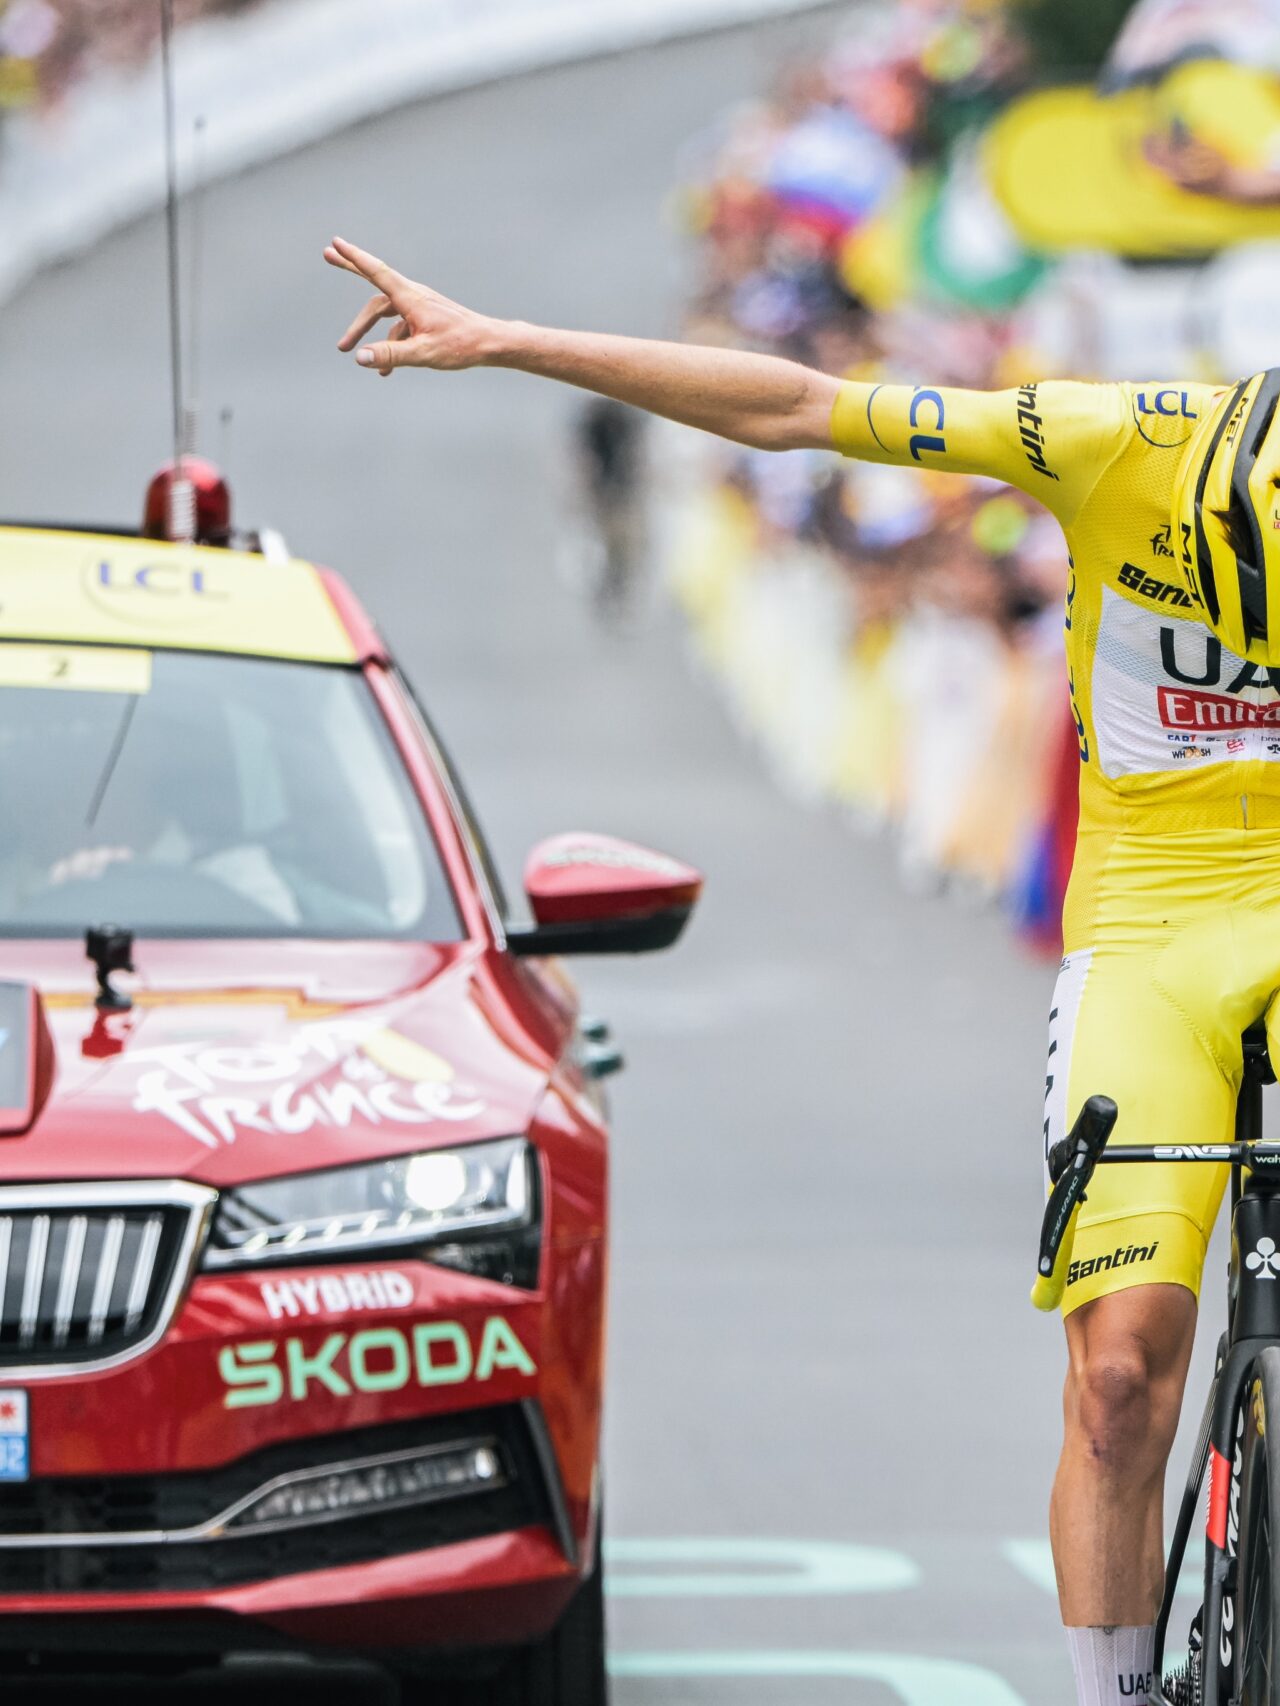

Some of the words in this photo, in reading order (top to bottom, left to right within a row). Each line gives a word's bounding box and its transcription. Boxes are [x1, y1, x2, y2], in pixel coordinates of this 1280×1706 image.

[908, 385, 946, 461] CL
[1136, 390, 1198, 420] LCL
[1017, 384, 1060, 482] antini
[99, 560, 233, 602] LCL
[1066, 1241, 1160, 1287] Santini
[260, 1270, 414, 1319] HYBRID
